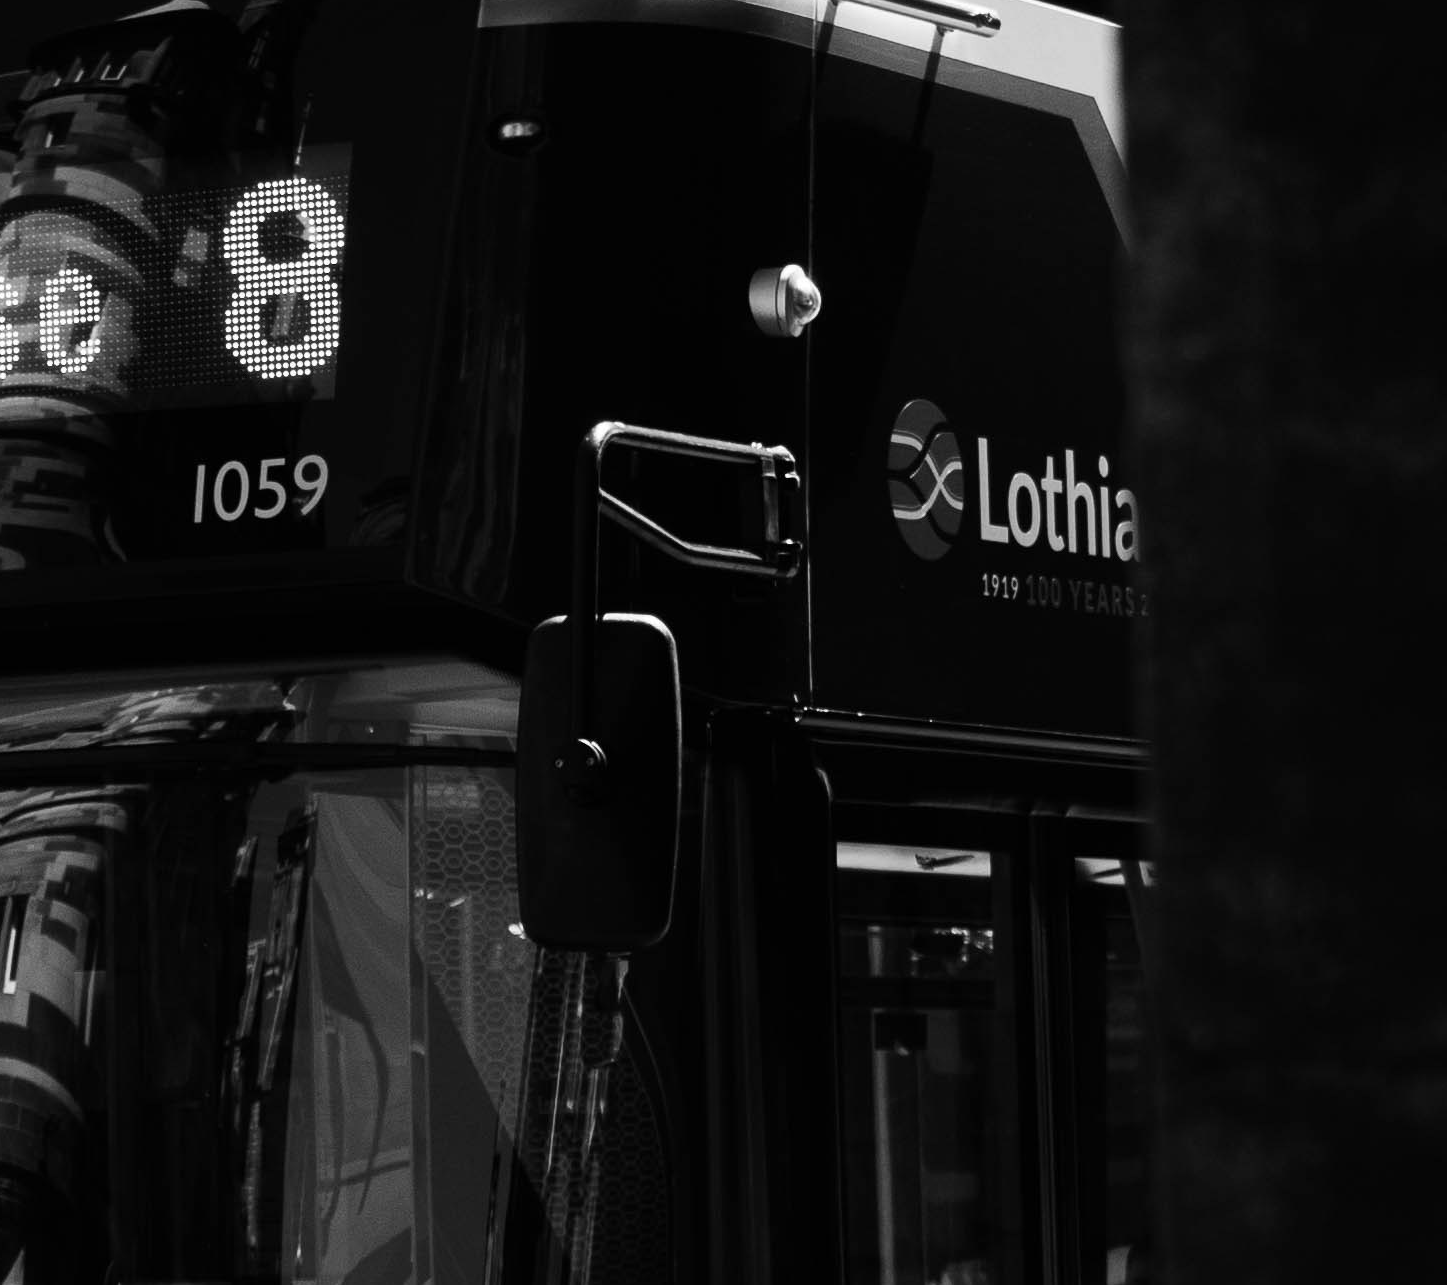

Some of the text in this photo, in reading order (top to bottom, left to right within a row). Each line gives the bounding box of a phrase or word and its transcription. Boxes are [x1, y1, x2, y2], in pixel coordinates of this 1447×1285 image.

[223, 178, 344, 379] 8
[193, 455, 329, 523] 1059
[978, 437, 1140, 563] Lothia
[982, 572, 1019, 599] 1919
[1026, 574, 1061, 607] 100
[1069, 580, 1136, 616] YEARS
